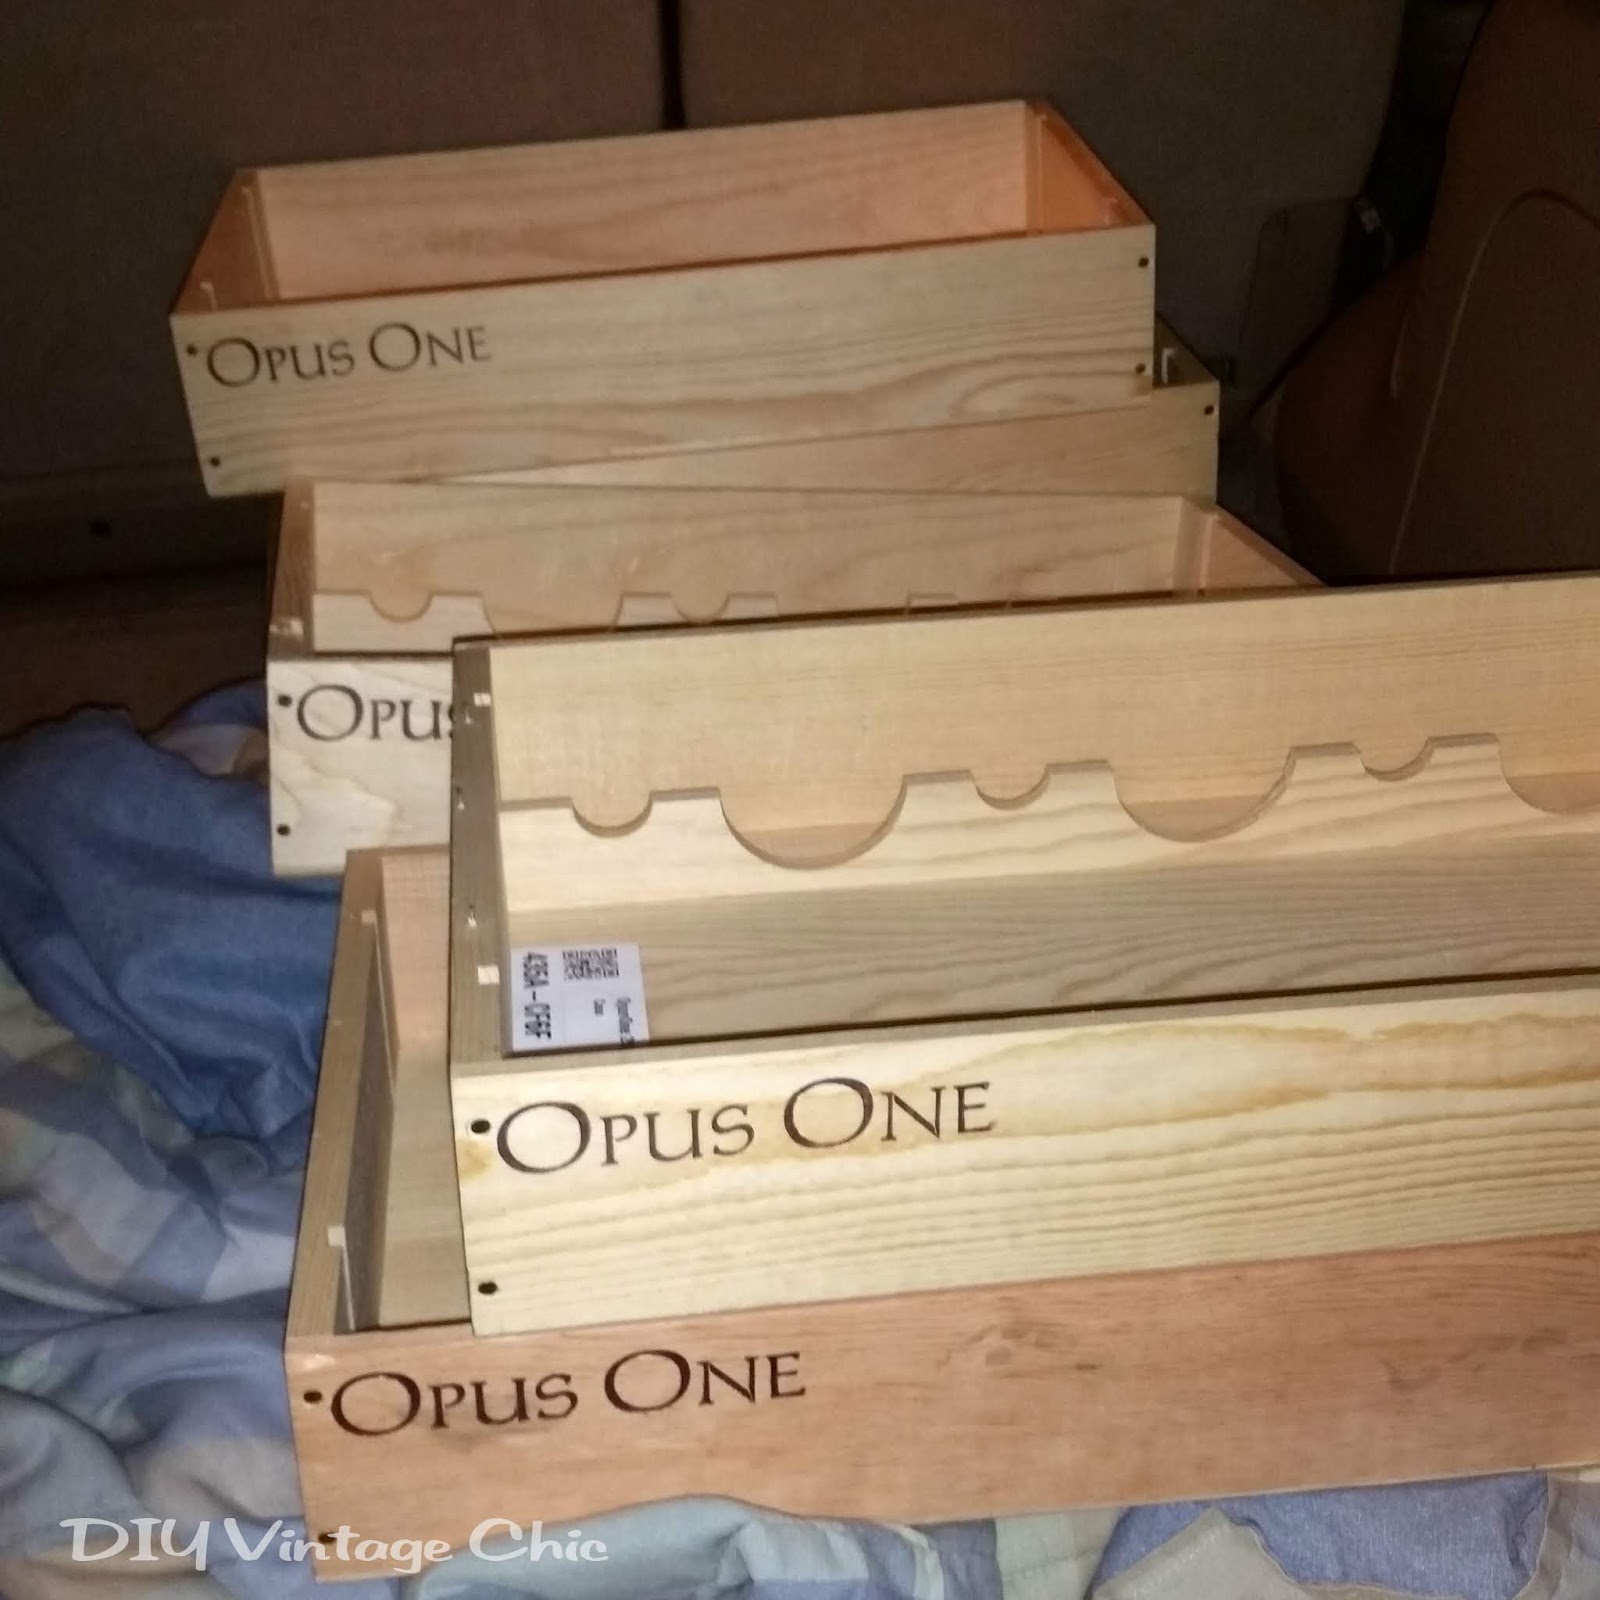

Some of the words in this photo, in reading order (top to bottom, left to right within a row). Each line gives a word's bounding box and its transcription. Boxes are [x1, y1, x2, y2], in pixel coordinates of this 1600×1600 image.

[206, 336, 355, 388] OPUS
[369, 322, 492, 372] ONE
[297, 684, 453, 742] OPU
[497, 1100, 755, 1174] OPUS
[784, 1077, 998, 1149] ONE
[331, 1371, 579, 1436] OPUS
[604, 1349, 806, 1412] ONE
